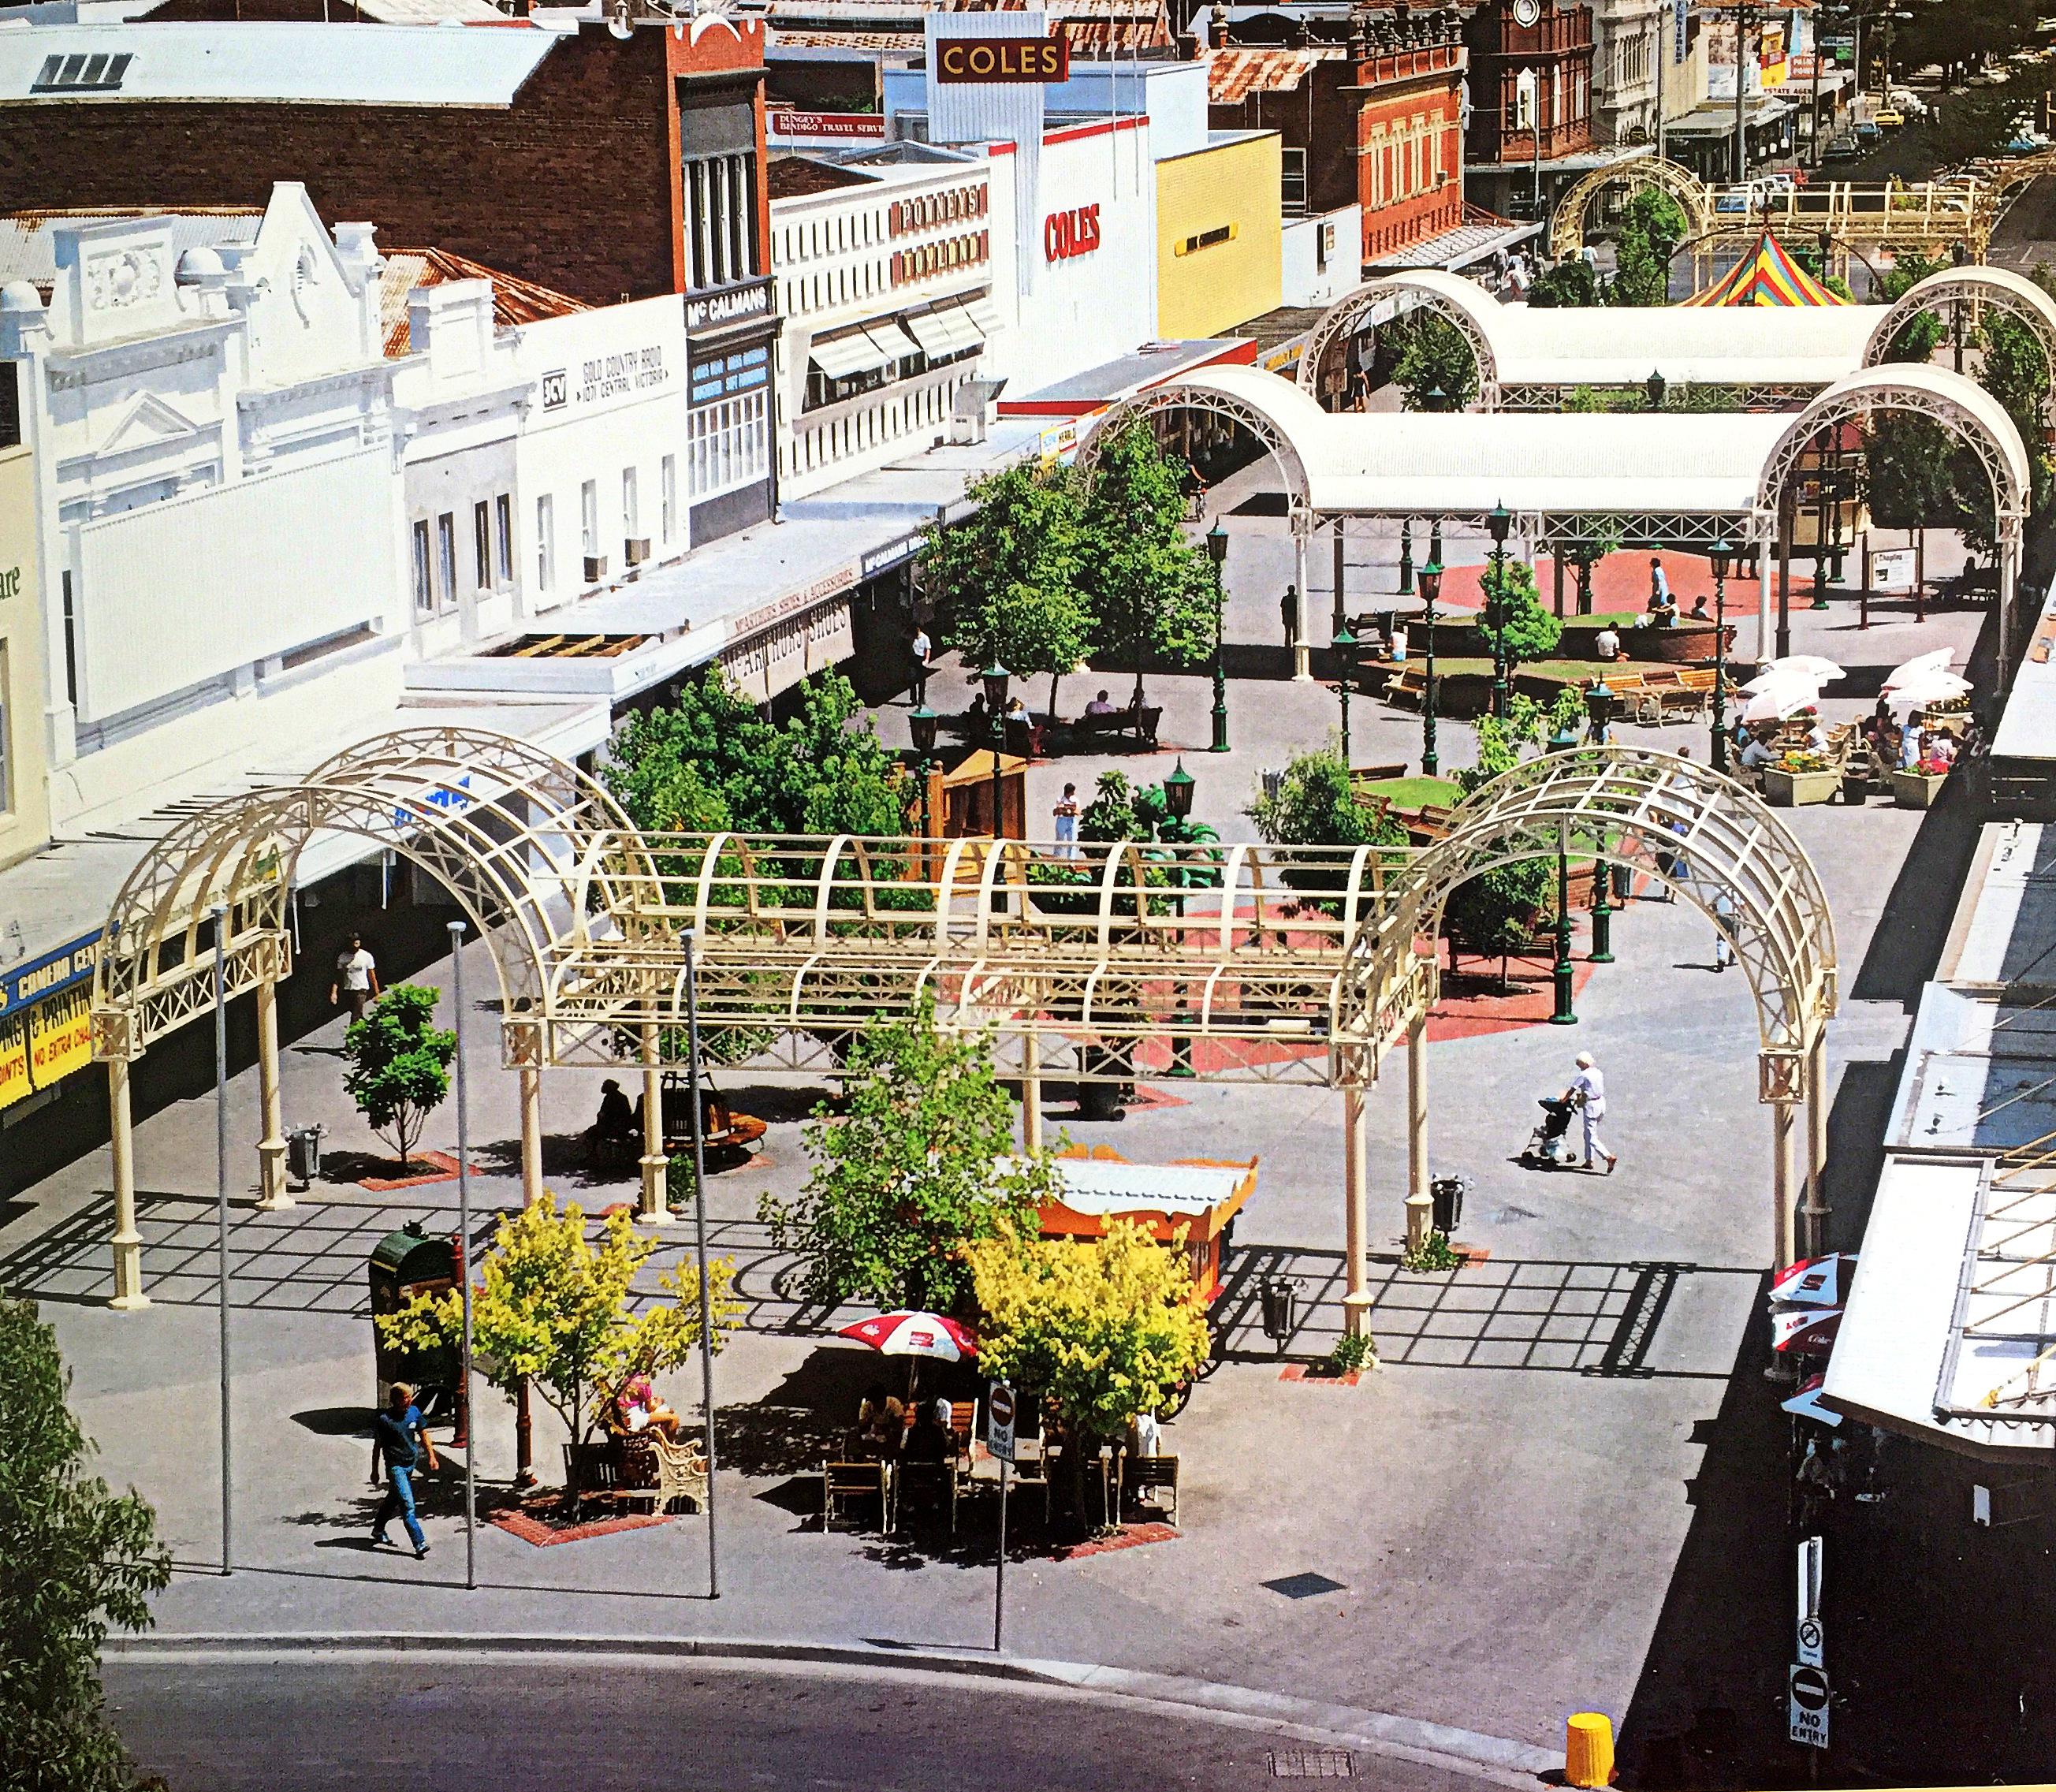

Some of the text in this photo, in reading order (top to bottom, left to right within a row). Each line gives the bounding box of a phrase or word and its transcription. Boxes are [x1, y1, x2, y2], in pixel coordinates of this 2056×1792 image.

[944, 46, 1058, 74] COLES
[779, 115, 823, 124] DUNGEY'S
[780, 123, 818, 132] BENDIGO
[822, 124, 854, 132] TRAVEL
[1044, 203, 1101, 263] COLES
[903, 236, 978, 277] TOYLAND
[605, 352, 638, 378] COUNTRY
[641, 345, 662, 370] RADIO
[601, 377, 631, 399] CENTRAL
[635, 368, 663, 389] VICTORIA
[809, 598, 847, 642] SHOES
[17, 956, 71, 1000] CAMERA
[42, 982, 93, 1033] PRINTIN
[34, 1047, 45, 1067] NO
[49, 1034, 71, 1062] EXTRA
[994, 1427, 1008, 1443] NO
[1792, 1725, 1827, 1744] ENTRY
[1800, 1711, 1821, 1727] NO
